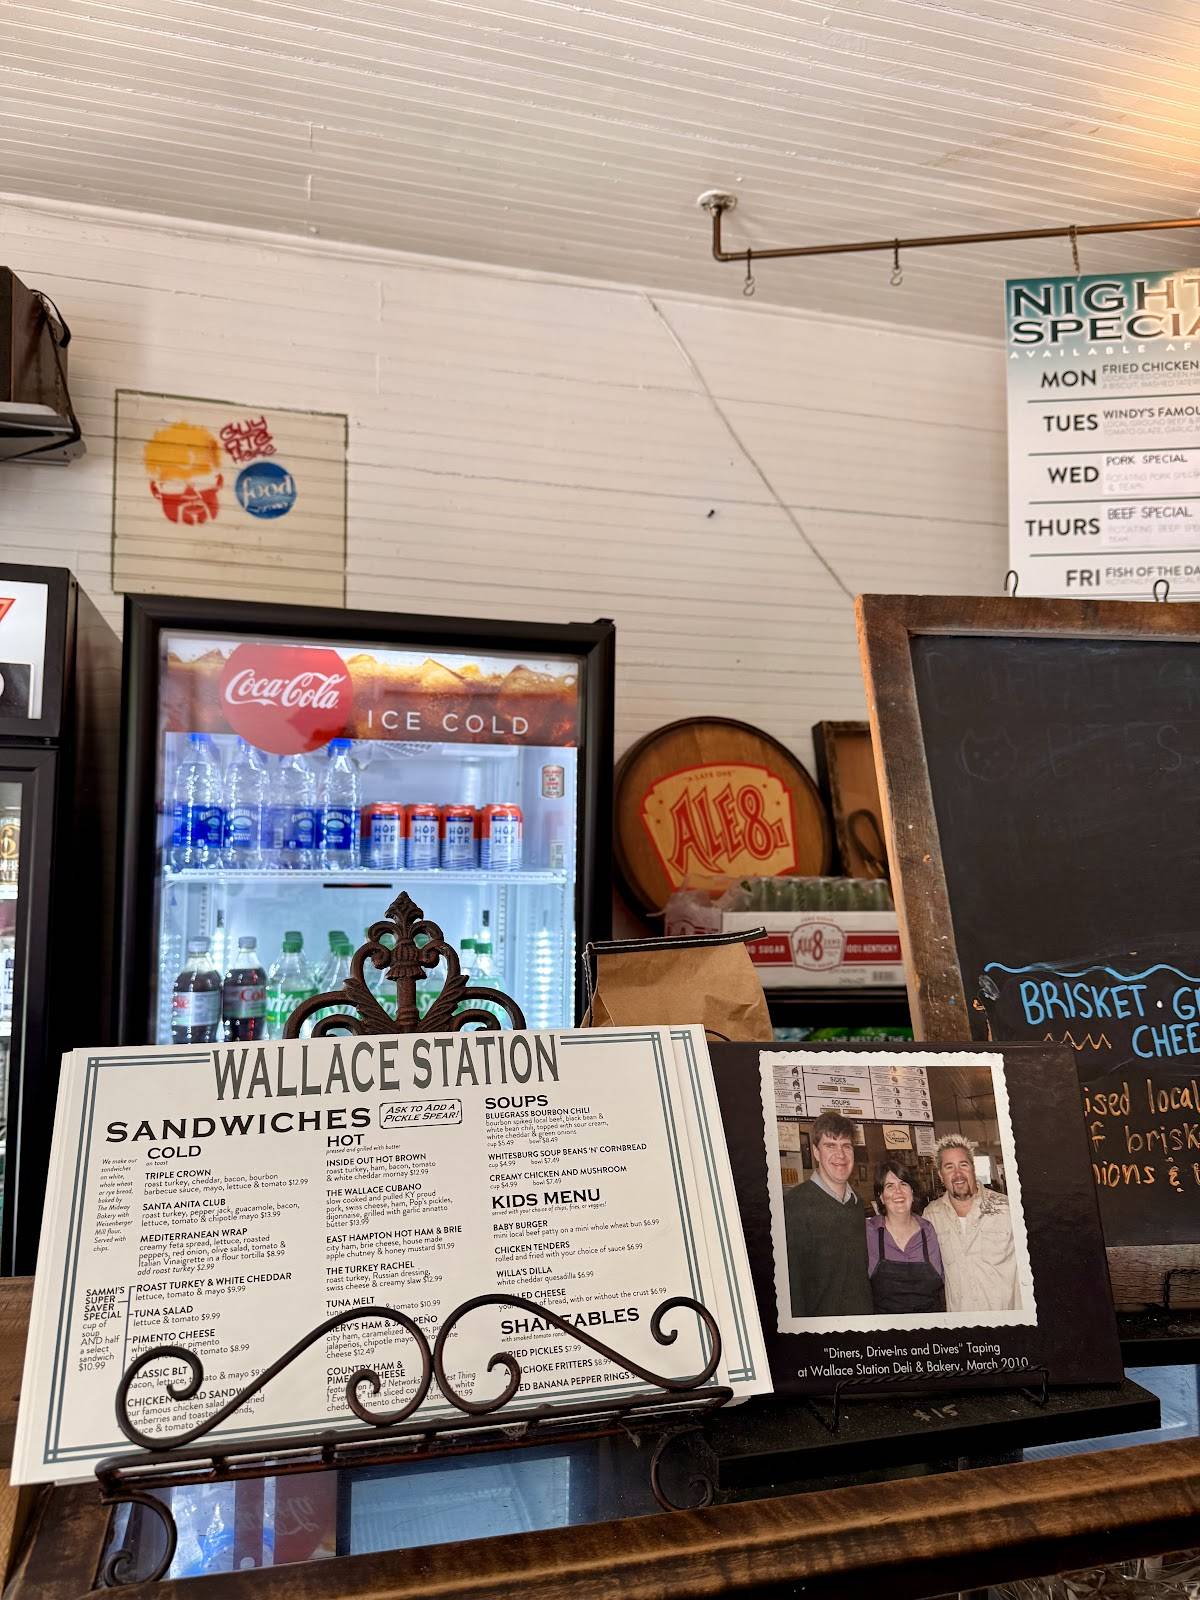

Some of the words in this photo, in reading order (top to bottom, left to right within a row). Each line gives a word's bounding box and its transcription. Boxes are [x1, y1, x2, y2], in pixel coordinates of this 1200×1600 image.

[1010, 344, 1146, 359] AVAILABLE
[1101, 363, 1140, 374] FRIED
[1141, 360, 1200, 373] CHICKEN
[1041, 369, 1097, 389] MON
[1102, 408, 1156, 420] WINDY'S
[1043, 413, 1099, 432] TUES
[1105, 455, 1137, 467] PORK
[1142, 453, 1189, 465] SPECIAL
[1047, 466, 1099, 484] WED
[1106, 506, 1137, 520] BEEF
[1140, 505, 1193, 519] SPECIAL
[1025, 518, 1100, 537] THURS
[1065, 569, 1101, 588] FRI
[1105, 566, 1135, 578] FISH
[1135, 566, 1156, 577] OF
[1156, 565, 1182, 577] THE
[225, 668, 348, 710] Coca-Cola
[367, 709, 421, 730] ICE
[442, 712, 530, 735] COLD
[1019, 980, 1148, 1025] BRISKET
[212, 1039, 400, 1101] WALLACE
[412, 1034, 561, 1090] STATION
[485, 1094, 549, 1110] SOUPS
[485, 1110, 529, 1120] BLUEGRASS
[530, 1108, 569, 1117] BOURBON
[570, 1107, 590, 1115] CHILI
[105, 1107, 371, 1143] SANDWICHES
[327, 1133, 365, 1148] HOT
[147, 1145, 201, 1160] COLD
[487, 1150, 539, 1161] WHITESBURG
[540, 1149, 561, 1158] SOUP
[562, 1147, 588, 1155] BEANS
[599, 1143, 647, 1153] CORNBREAD
[326, 1158, 354, 1167] INSIDE
[356, 1157, 373, 1165] OUT
[376, 1155, 394, 1163] HOT
[395, 1153, 427, 1162] BROWN
[145, 1171, 174, 1180] TRIPLE
[176, 1169, 211, 1179] CROWN
[489, 1172, 522, 1183] CREAMY
[523, 1170, 559, 1180] CHICKEN
[561, 1168, 578, 1177] AND
[580, 1165, 627, 1175] MUSHROOM
[261, 1180, 287, 1188] tomato
[288, 1178, 309, 1187] $12.99
[326, 1189, 343, 1197] THE
[344, 1185, 384, 1196] WALLACE
[385, 1183, 422, 1193] CUBANO
[142, 1202, 172, 1212] SANTA
[173, 1200, 201, 1210] ANITA
[202, 1198, 226, 1208] CLUB
[491, 1193, 538, 1209] KIDS
[543, 1188, 600, 1205] MENU
[493, 1222, 514, 1231] BABY
[515, 1220, 548, 1230] BURGER
[140, 1229, 220, 1243] MEDITERRANEAN
[221, 1228, 248, 1238] WRAP
[326, 1235, 347, 1244] EAST
[349, 1230, 392, 1242] HAMPTON
[394, 1229, 412, 1238] HOT
[414, 1228, 434, 1237] HAM
[436, 1227, 442, 1235] &
[443, 1225, 462, 1233] BRIE
[494, 1244, 532, 1254] CHICKEN
[533, 1241, 570, 1251] TENDERS
[326, 1266, 343, 1275] THE
[345, 1264, 379, 1274] TURKEY
[380, 1261, 415, 1271] RACHEL
[496, 1267, 528, 1278] WILLA'S
[529, 1266, 553, 1275] DILLA
[136, 1283, 167, 1293] ROAST
[168, 1280, 205, 1291] TURKEY
[207, 1279, 214, 1287] &
[215, 1276, 245, 1287] WHITE
[246, 1272, 292, 1283] CHEDDAR
[86, 1286, 125, 1297] SAMMI'S
[85, 1295, 116, 1304] SUPER
[326, 1299, 350, 1309] TUNA
[352, 1296, 375, 1306] MELT
[84, 1303, 115, 1312] SAVER
[134, 1307, 161, 1318] TUNA
[162, 1305, 194, 1316] SALAD
[83, 1311, 122, 1321] SPECIAL
[133, 1318, 161, 1327] lettuce
[163, 1317, 170, 1325] &
[171, 1315, 199, 1324] tomato
[201, 1312, 220, 1322] $9.99
[132, 1332, 176, 1344] PIMENTO
[178, 1329, 216, 1340] CHEESE
[529, 1345, 564, 1357] PICKLES
[866, 1344, 908, 1358] Drive-Ins
[911, 1343, 930, 1356] and
[932, 1342, 963, 1355] Dives"
[965, 1341, 1001, 1357] Taping
[78, 1361, 106, 1372] $10.99
[504, 1363, 554, 1377] AICHOKE
[555, 1359, 593, 1370] FRITTERS
[798, 1368, 808, 1378] at
[810, 1365, 853, 1377] Wallace
[856, 1363, 890, 1375] Station
[893, 1362, 912, 1374] Deli
[916, 1362, 924, 1373] &
[967, 1358, 998, 1371] March
[1001, 1356, 1030, 1369] 2010
[532, 1379, 570, 1391] BANANA
[570, 1375, 603, 1387] PEPPER
[603, 1371, 630, 1382] RINGS
